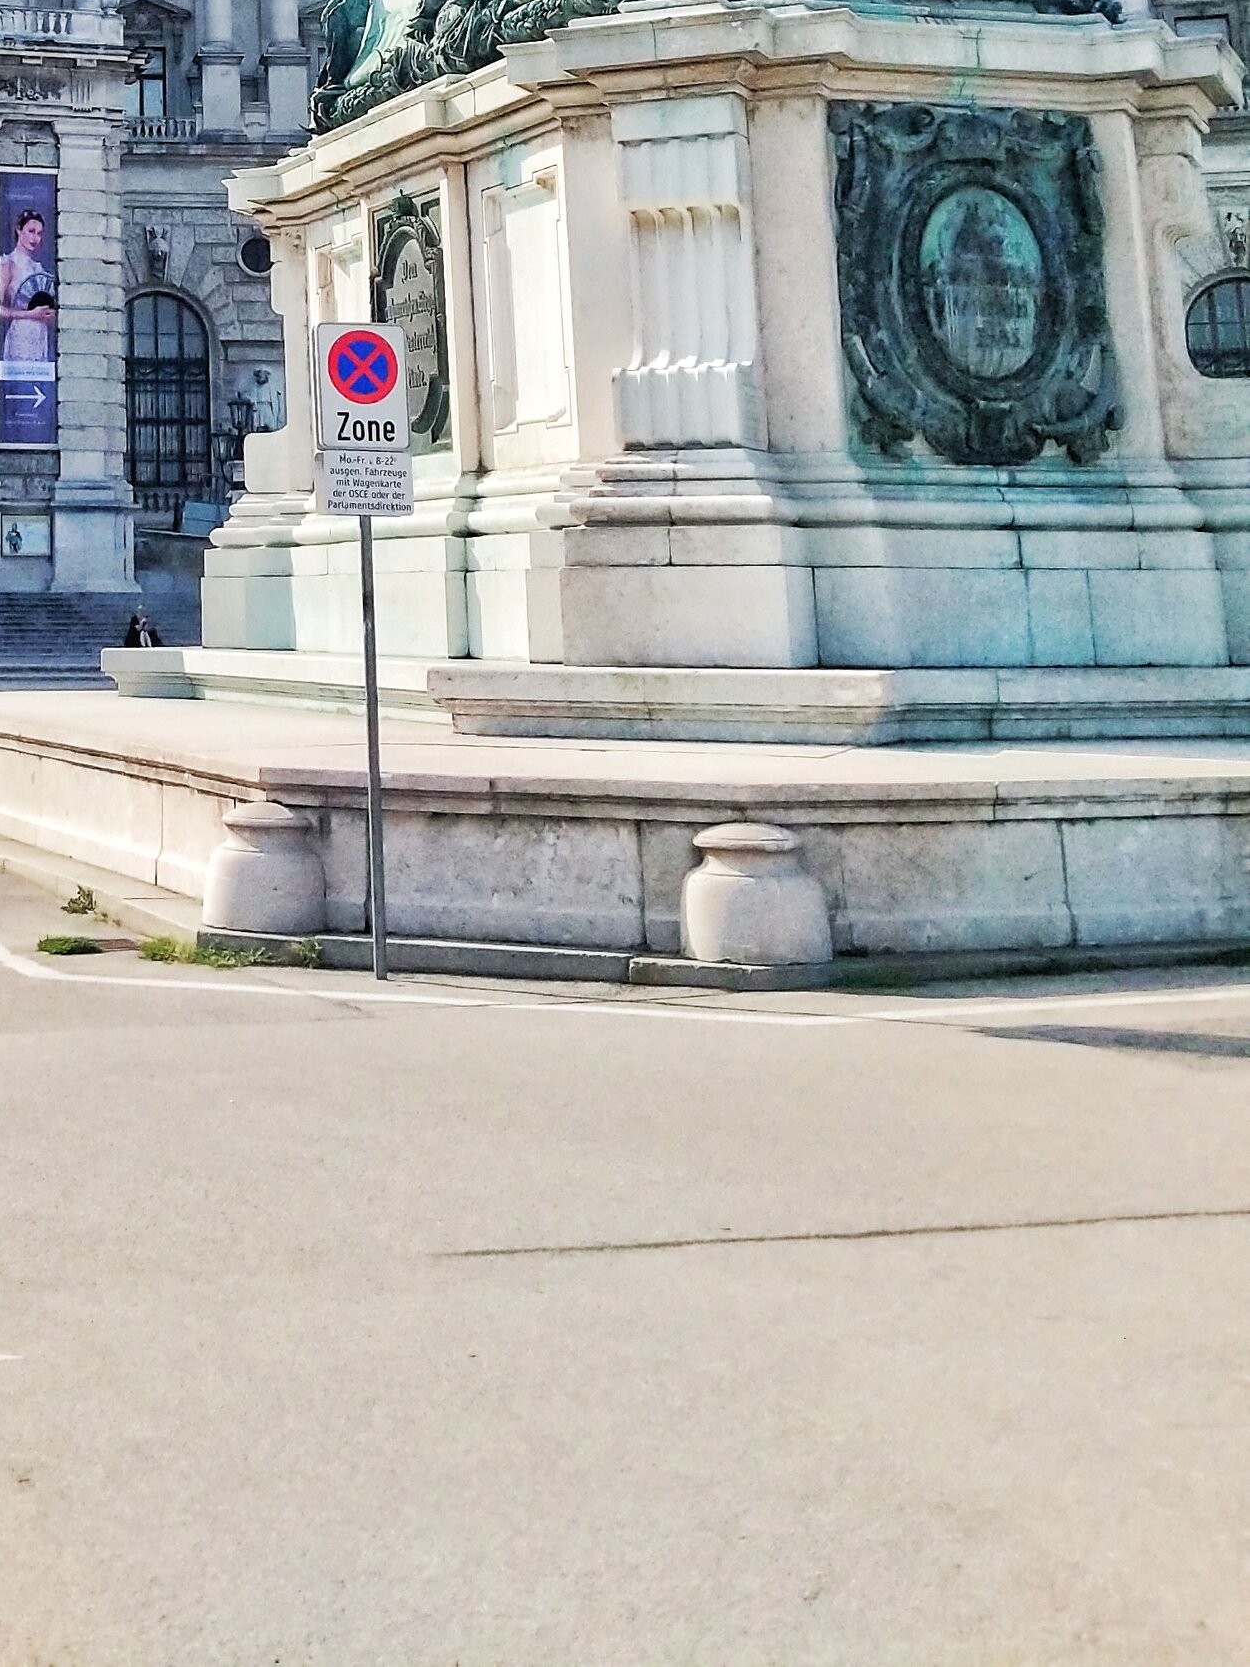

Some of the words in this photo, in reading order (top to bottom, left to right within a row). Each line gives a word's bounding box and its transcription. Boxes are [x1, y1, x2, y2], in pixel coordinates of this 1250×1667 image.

[336, 411, 396, 442] Zone
[364, 467, 408, 479] Fahrzeuge
[336, 477, 351, 487] mit
[352, 478, 402, 489] Wagenkarte
[332, 489, 346, 498] der
[348, 489, 369, 499] OSCE
[371, 491, 390, 499] oder
[391, 491, 406, 500] der
[327, 499, 412, 512] Parlamentsdirektion
